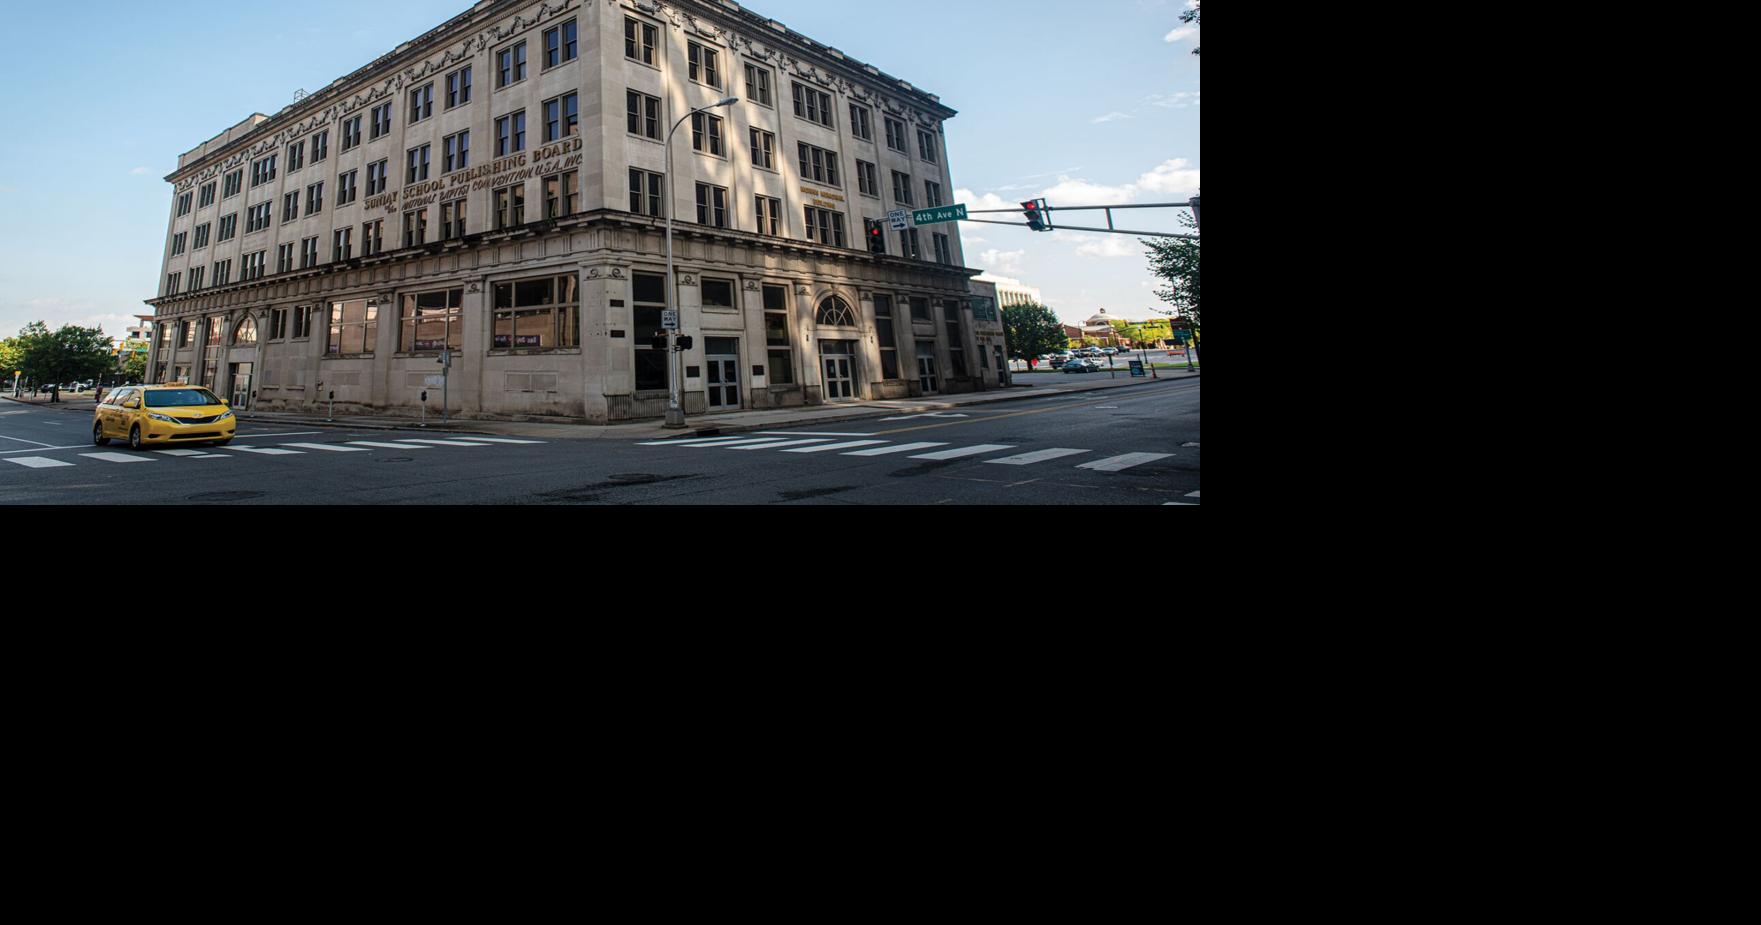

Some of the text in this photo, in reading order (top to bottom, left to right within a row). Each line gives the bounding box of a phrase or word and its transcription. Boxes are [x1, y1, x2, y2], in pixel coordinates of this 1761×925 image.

[364, 138, 583, 210] SUNDAY SCHOOL PUBLISHING BOARD
[915, 208, 965, 222] 4th Ave N
